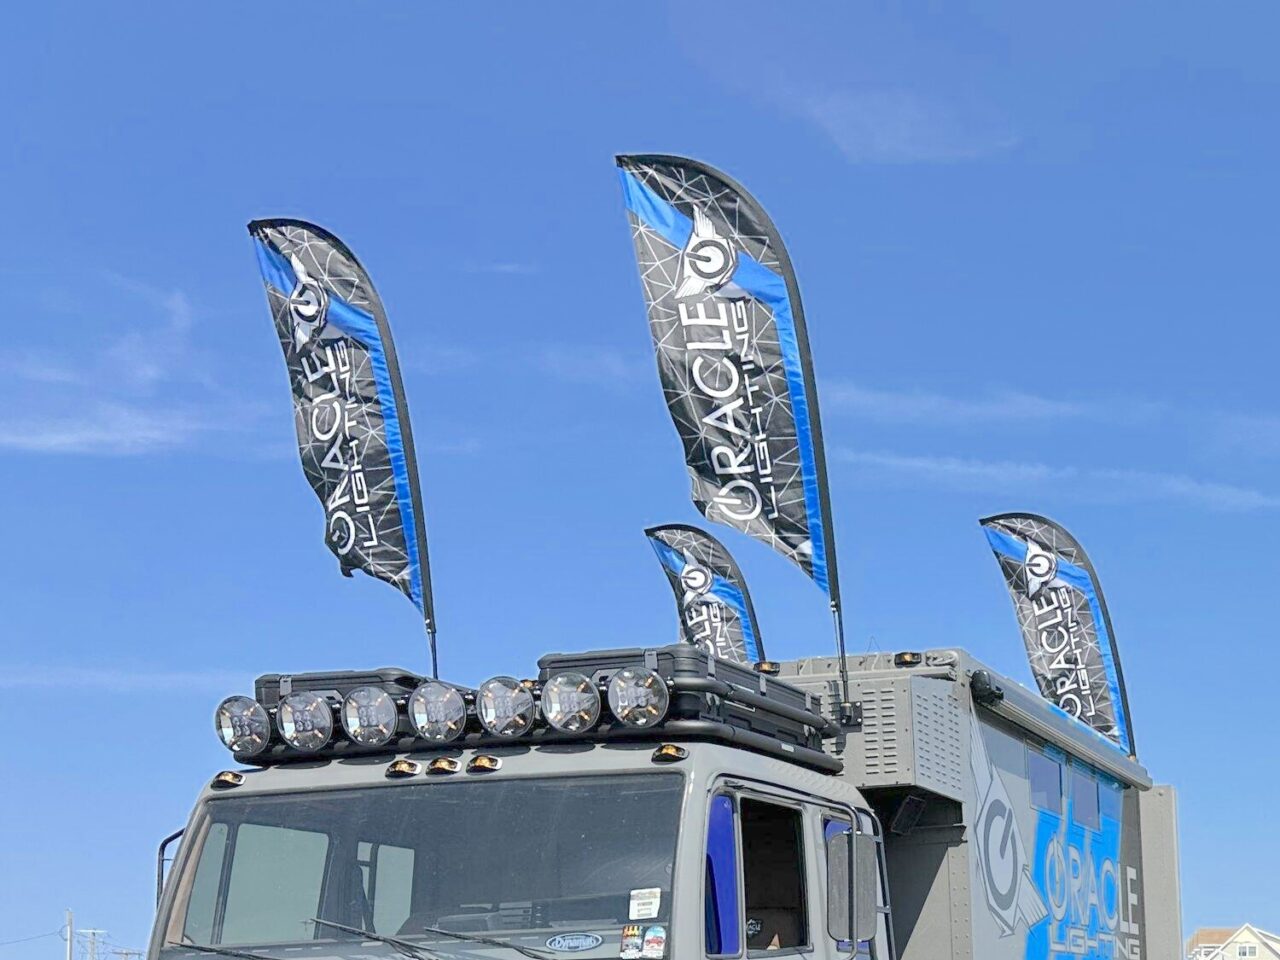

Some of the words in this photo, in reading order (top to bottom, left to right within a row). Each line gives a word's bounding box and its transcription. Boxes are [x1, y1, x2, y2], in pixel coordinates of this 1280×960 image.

[301, 346, 356, 556] ORACLE
[331, 339, 379, 549] LIGHTING
[679, 302, 763, 522] ORACLE
[727, 299, 779, 520] LIGHTING
[1032, 590, 1082, 719] ORACLE
[1058, 587, 1096, 717] LIGHTING
[1046, 832, 1139, 935] ORACLE
[1049, 924, 1140, 960] LIGHTING
